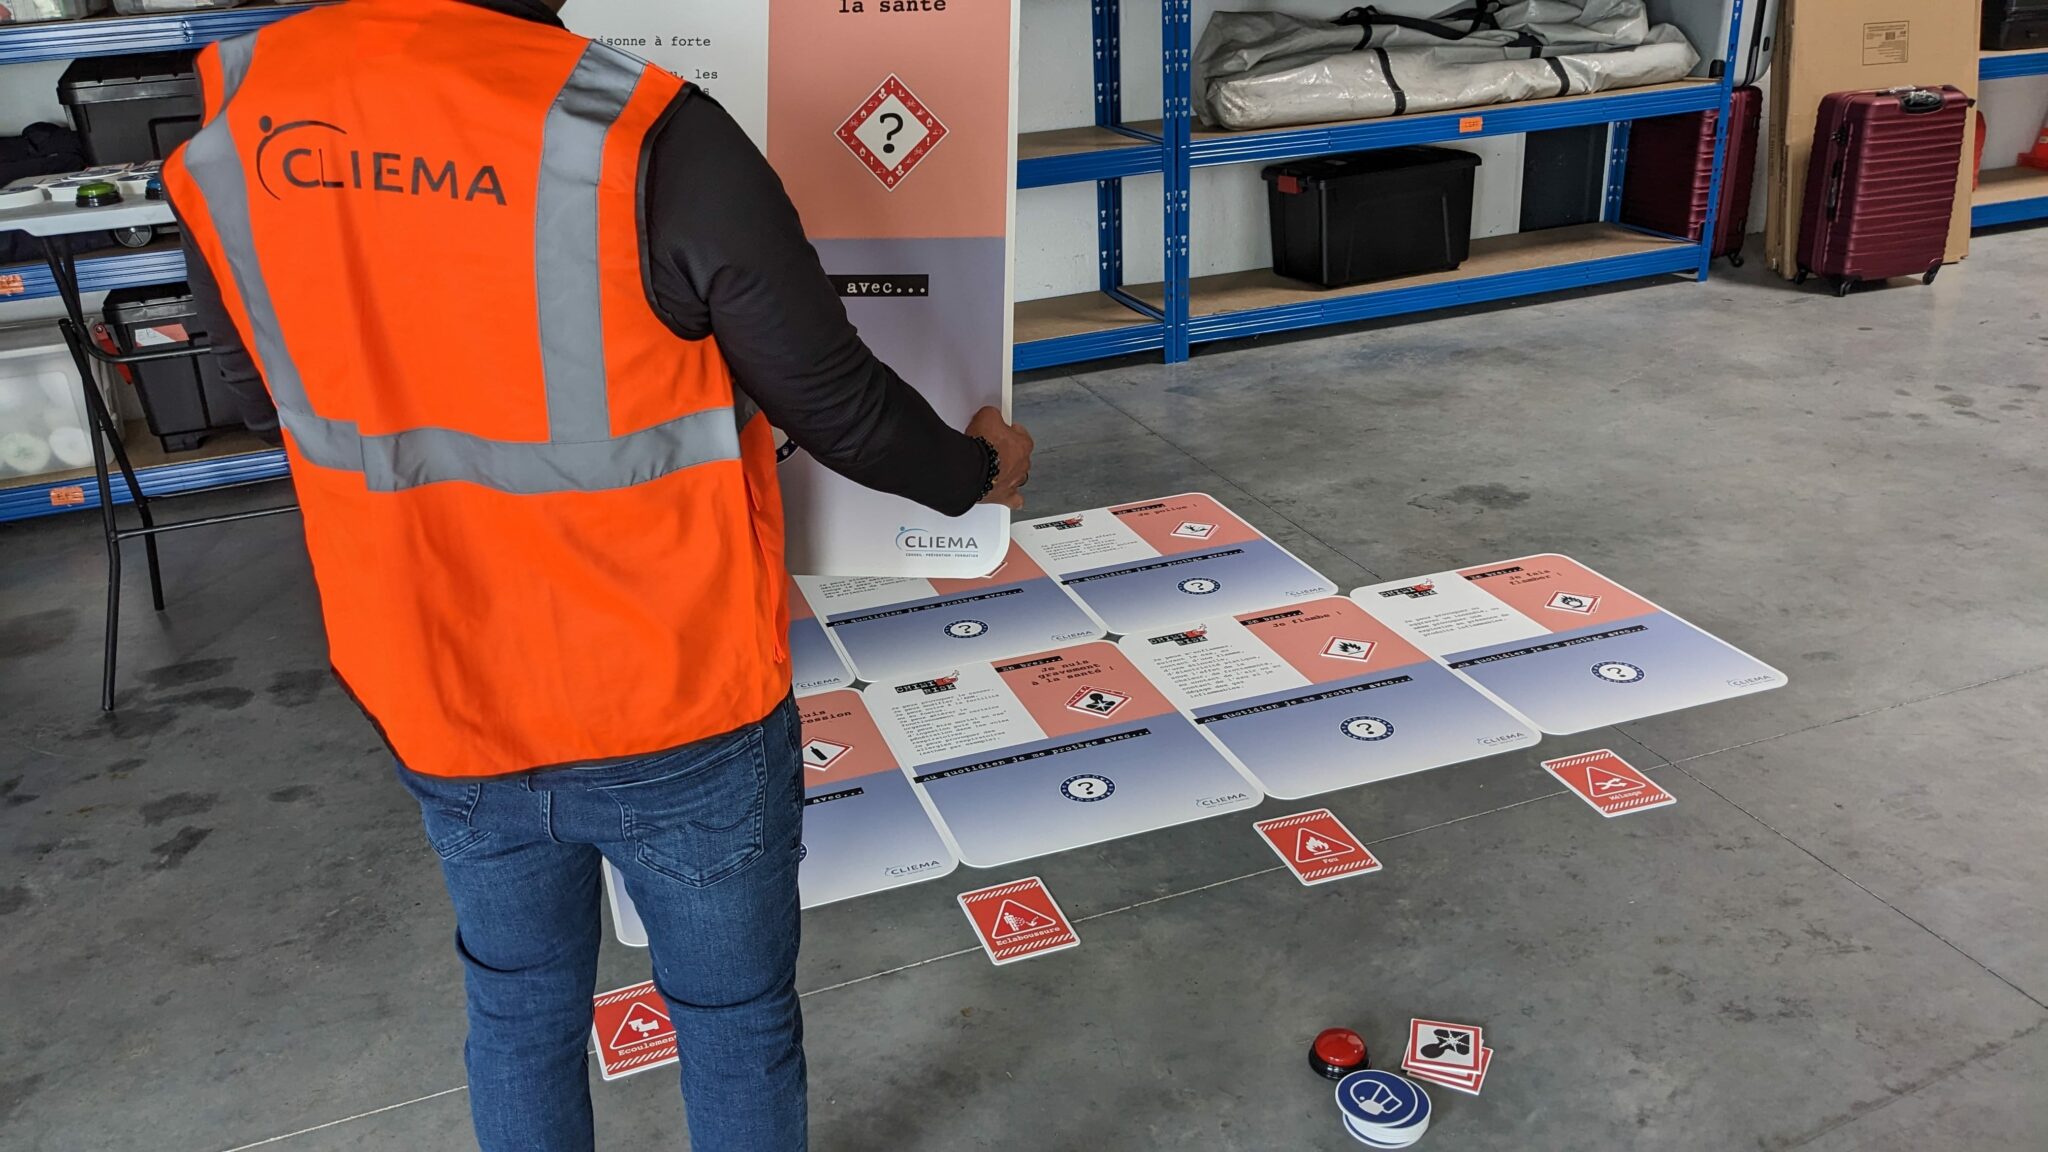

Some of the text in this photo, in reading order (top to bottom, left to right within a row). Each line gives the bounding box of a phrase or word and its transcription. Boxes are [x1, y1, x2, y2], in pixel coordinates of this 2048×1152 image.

[655, 36, 662, 46] à
[671, 36, 711, 46] forte
[695, 69, 718, 79] les
[282, 148, 507, 206] CLIEMA
[846, 282, 926, 294] avec...
[904, 535, 979, 549] CLIEMA
[1062, 659, 1089, 668] nuis
[1038, 663, 1101, 679] gravement
[1067, 668, 1102, 679] santé
[800, 677, 841, 688] CLIEMA
[801, 711, 852, 724] ression
[943, 759, 1006, 777] quotidien
[1052, 739, 1098, 756] protège
[1201, 792, 1247, 806] CLIEMA
[890, 860, 940, 875] CLIEMA
[996, 926, 1061, 946] Eclaboussure
